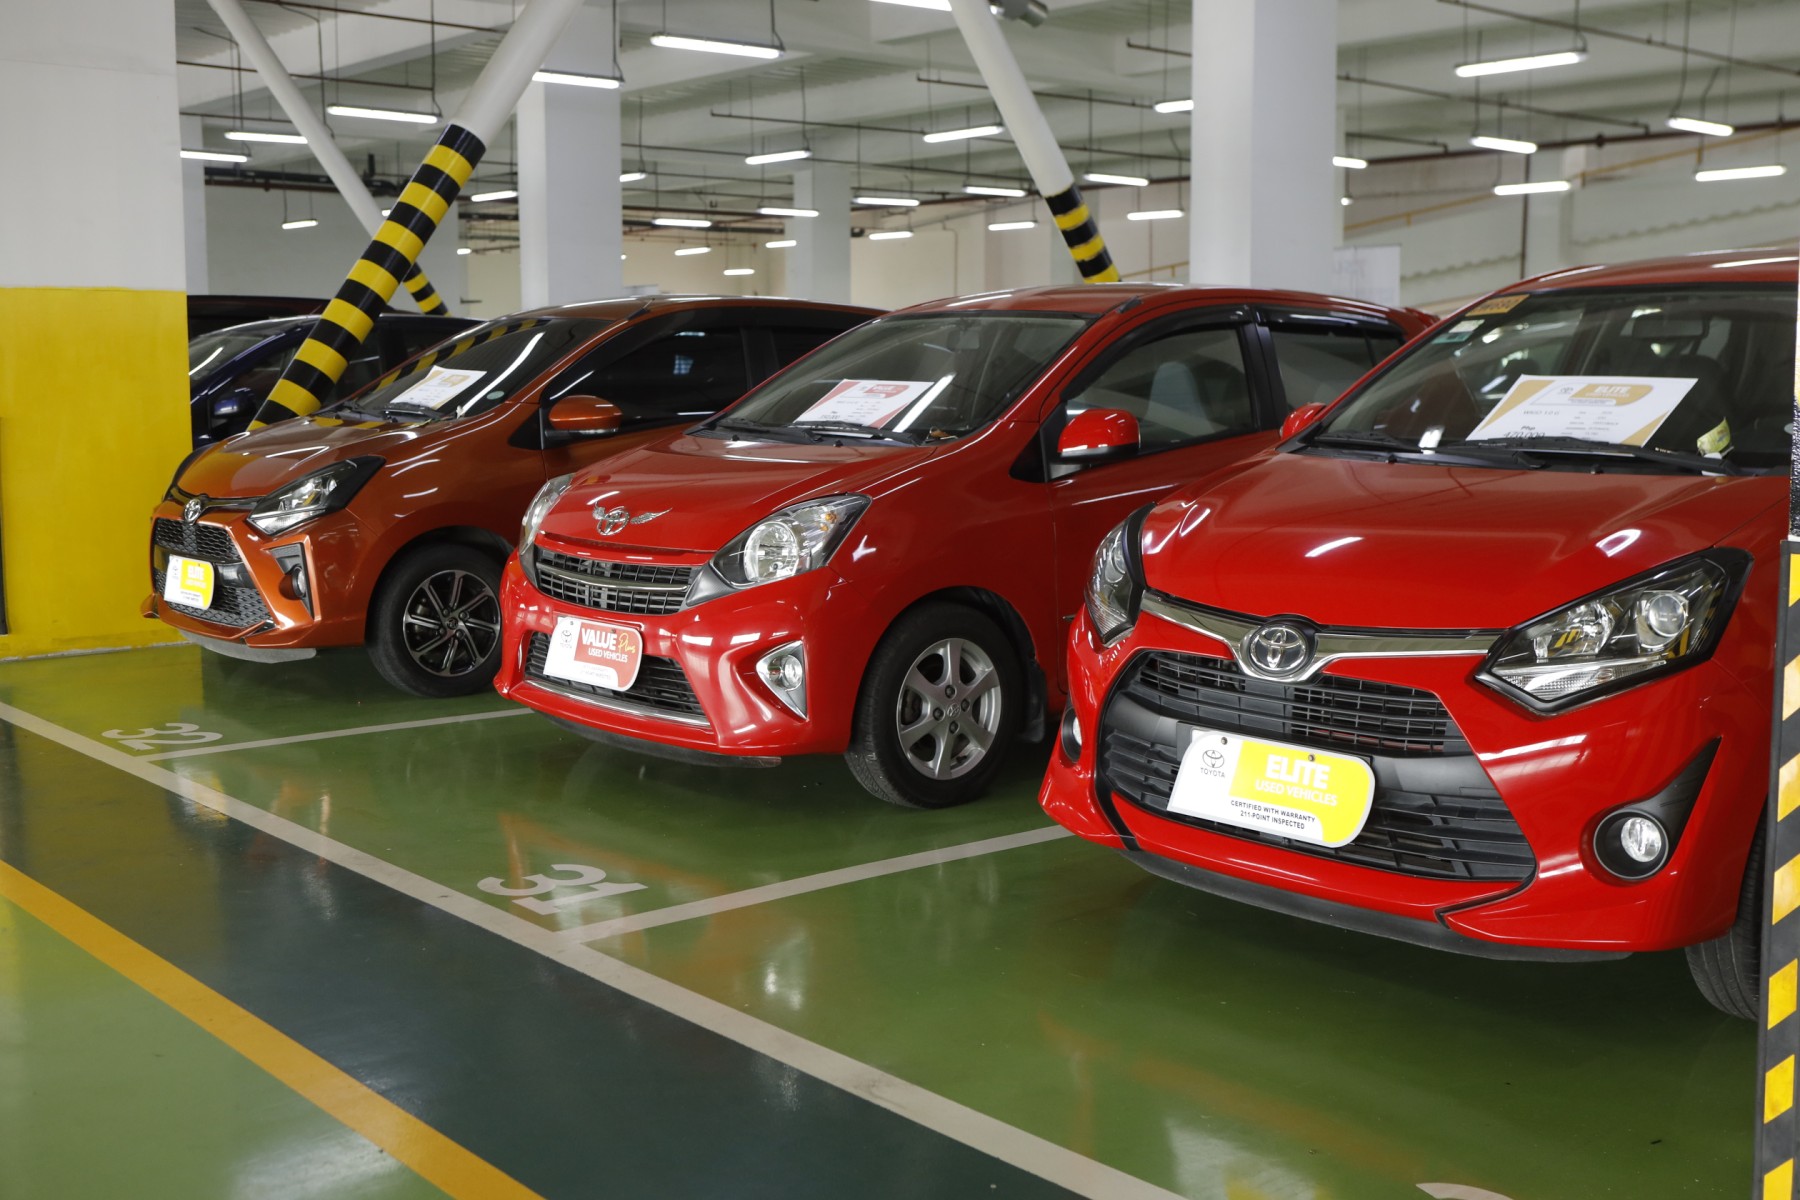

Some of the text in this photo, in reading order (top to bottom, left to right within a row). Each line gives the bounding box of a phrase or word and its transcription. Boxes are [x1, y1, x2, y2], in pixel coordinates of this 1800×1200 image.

[581, 628, 636, 654] VALUE Plus
[588, 647, 628, 663] USED VEHICLES
[1200, 767, 1226, 778] TOYOTA
[1266, 754, 1330, 789] ELITE
[1255, 779, 1338, 808] USED VEHICLES
[1230, 800, 1316, 823] CERTIFIED WITH WARRANTY
[1240, 810, 1306, 830] 211-POINT INSPECTED
